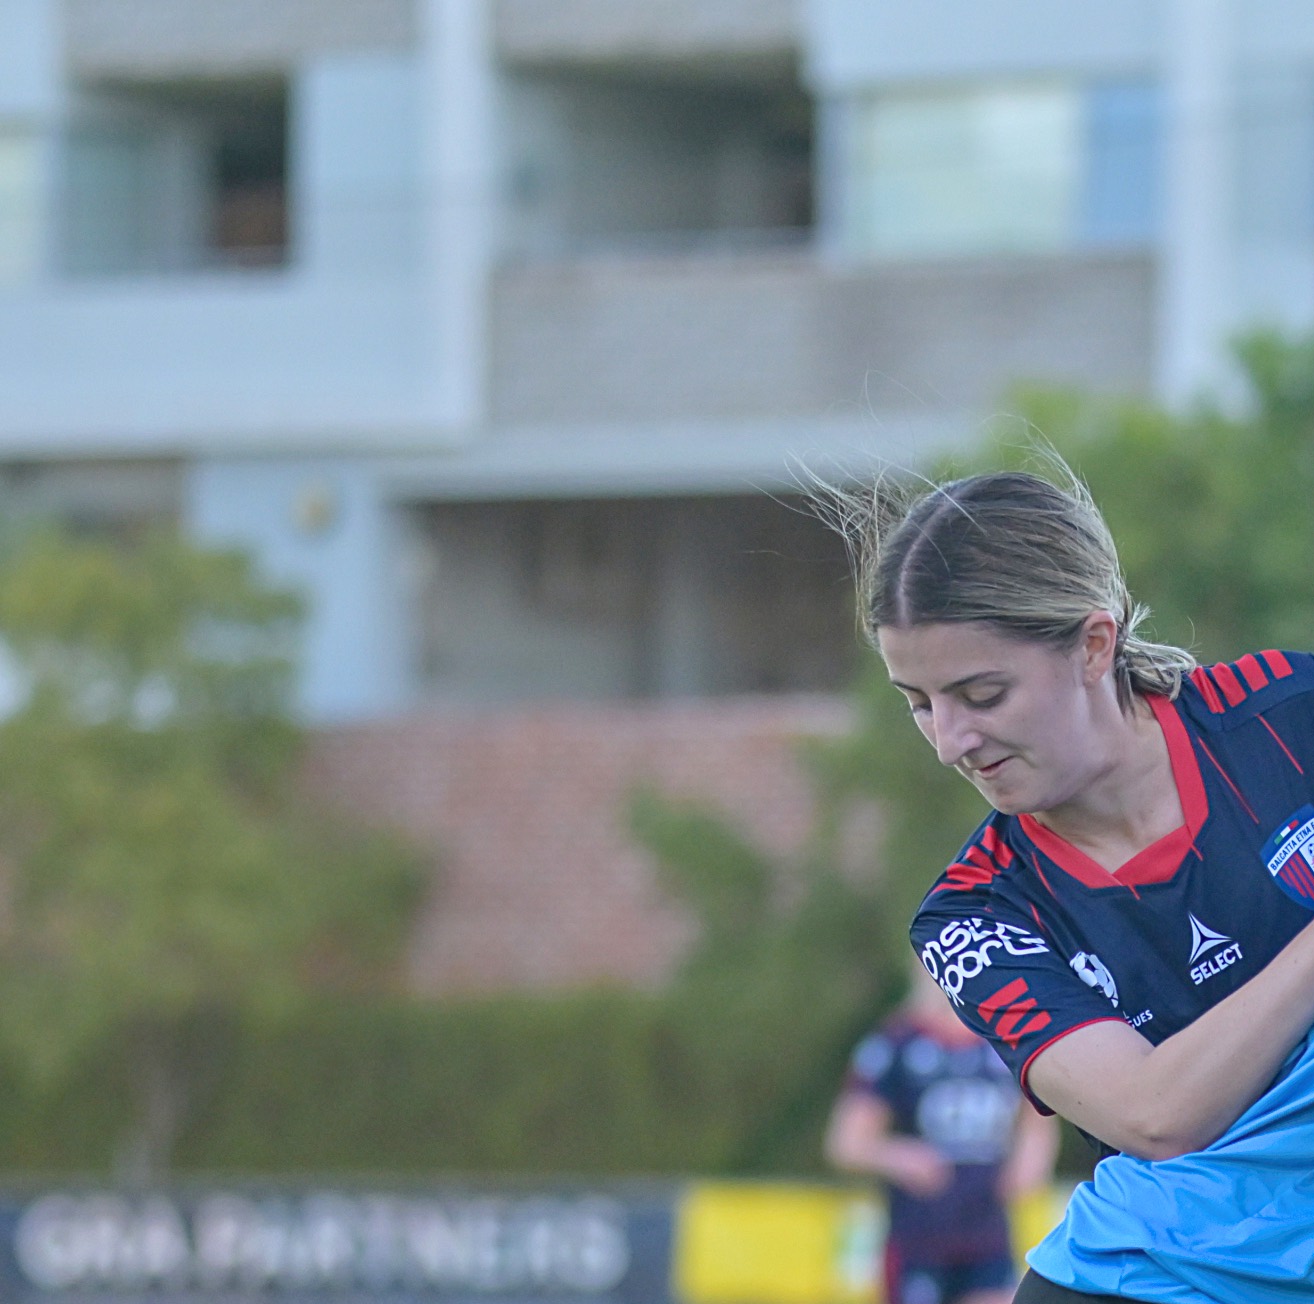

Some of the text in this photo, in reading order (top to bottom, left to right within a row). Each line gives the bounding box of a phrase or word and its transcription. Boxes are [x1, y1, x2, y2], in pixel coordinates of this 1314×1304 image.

[1270, 840, 1297, 871] BALCATTA
[1295, 826, 1311, 842] ETNA
[1190, 942, 1243, 986] SELECT
